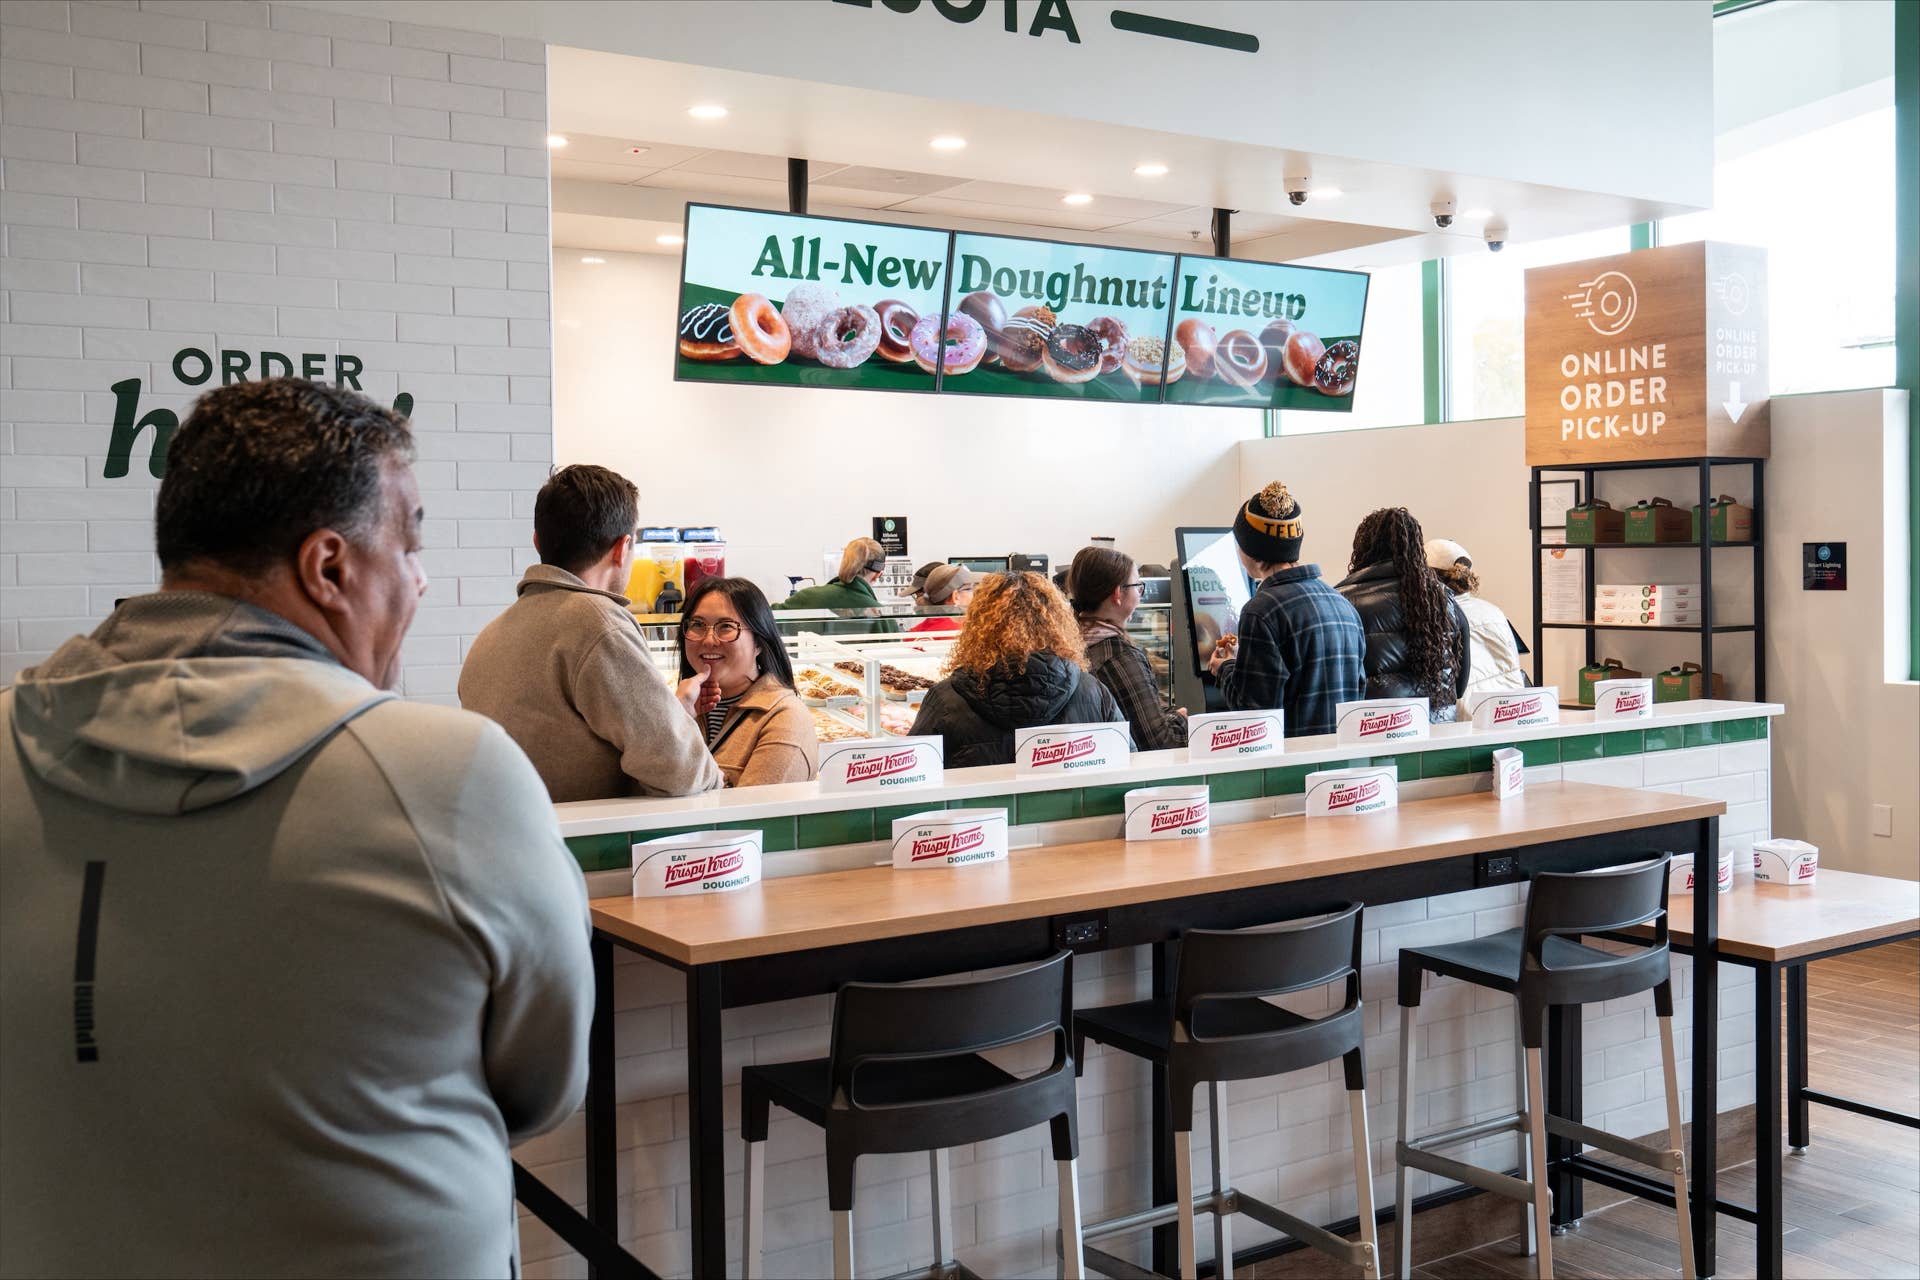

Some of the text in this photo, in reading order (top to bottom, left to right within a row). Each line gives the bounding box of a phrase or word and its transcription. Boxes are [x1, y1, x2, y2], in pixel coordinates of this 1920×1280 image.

[751, 235, 1306, 320] All-New Doughnut Lineup
[1717, 328, 1757, 343] ONLINE
[1561, 344, 1666, 378] ONLINE
[1716, 344, 1757, 360] ORDER
[172, 347, 364, 391] ORDER
[1716, 361, 1757, 374] PICK-UP
[1561, 377, 1666, 411] ORDER
[1561, 411, 1666, 441] PICK-UP
[1360, 715, 1389, 737] Krispy
[1032, 735, 1096, 768] Krispy Kreme
[1211, 728, 1242, 751] Krispy
[846, 748, 917, 784] Krispy Kreme
[1063, 758, 1106, 769] DOUGHNUTS
[880, 774, 926, 786] DOUGHNUTS
[1328, 787, 1358, 810] Krispy
[1151, 808, 1185, 833] Krispy
[911, 825, 985, 862] Krispy Kreme
[664, 848, 744, 889] Krispy Kreme
[947, 851, 995, 864] DOUGHNUTS
[702, 875, 750, 890] DOUGHNUTS
